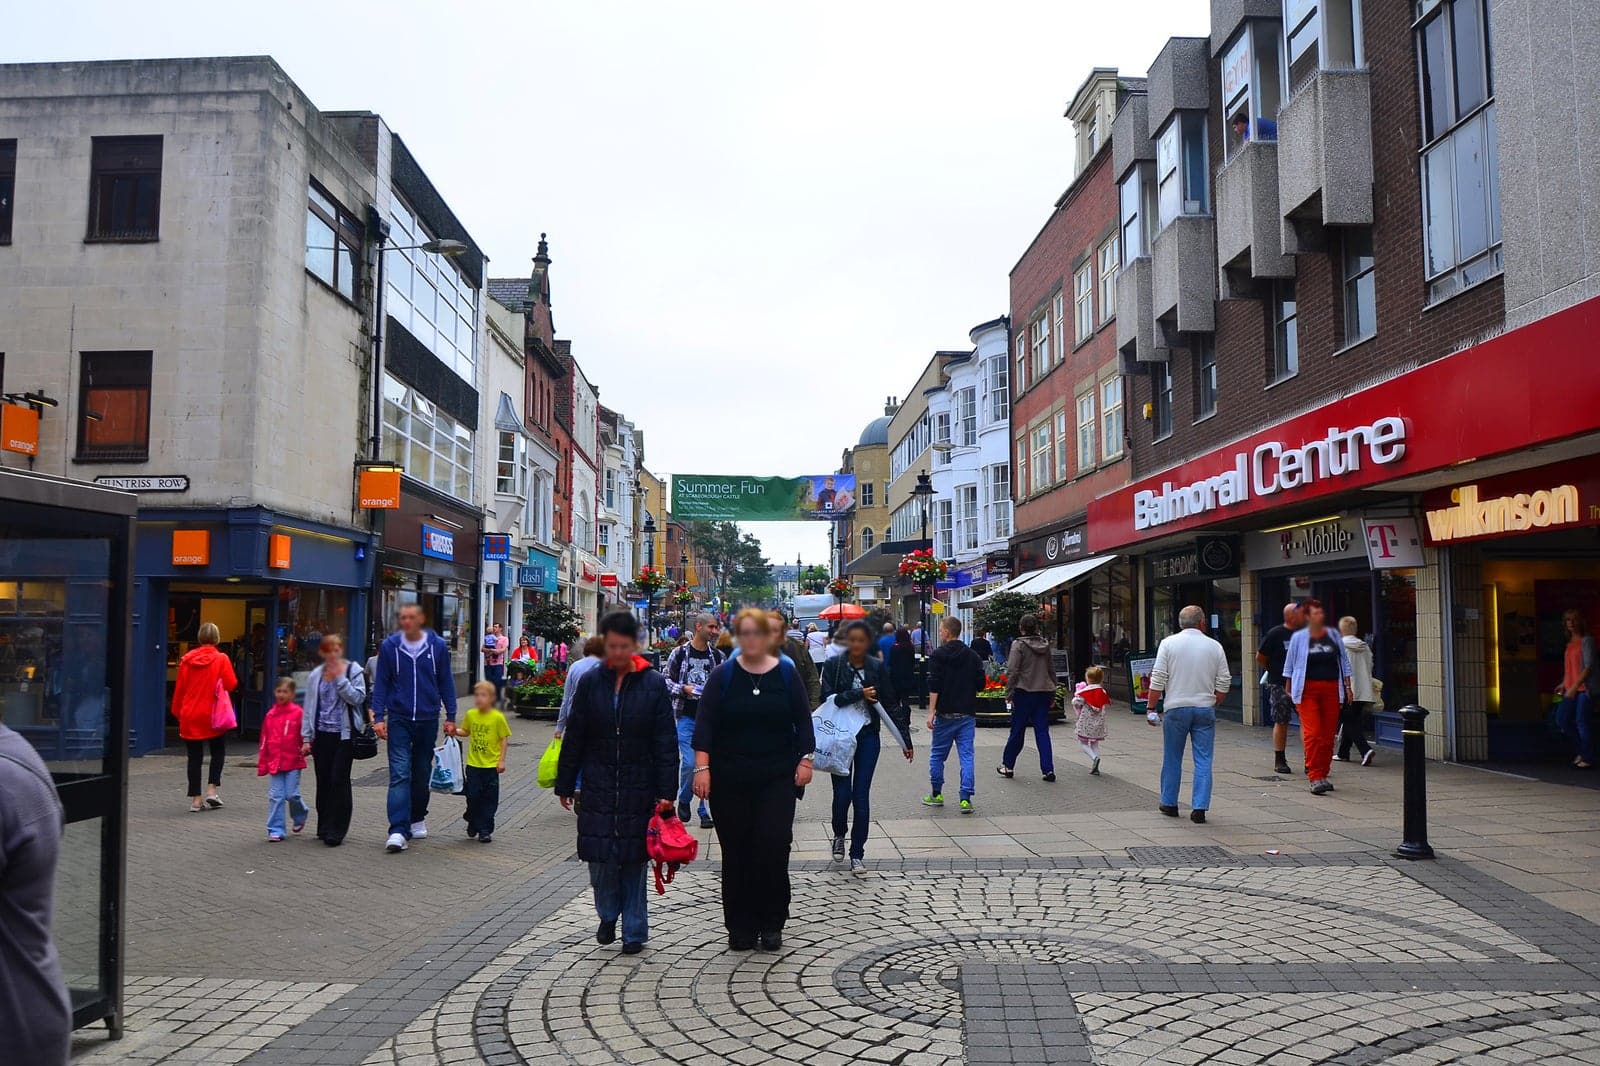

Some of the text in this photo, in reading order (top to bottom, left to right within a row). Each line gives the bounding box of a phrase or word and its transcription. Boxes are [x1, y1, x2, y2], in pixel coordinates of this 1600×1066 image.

[10, 440, 35, 453] orange
[1134, 417, 1406, 530] Balmoral Centre
[158, 479, 183, 488] ROW
[678, 479, 765, 494] Summer Fun
[361, 498, 393, 508] orange
[1426, 485, 1579, 541] wilkinson
[174, 555, 203, 565] orange
[1152, 559, 1168, 578] THE
[1169, 554, 1197, 577] BODY
[522, 568, 541, 584] dash
